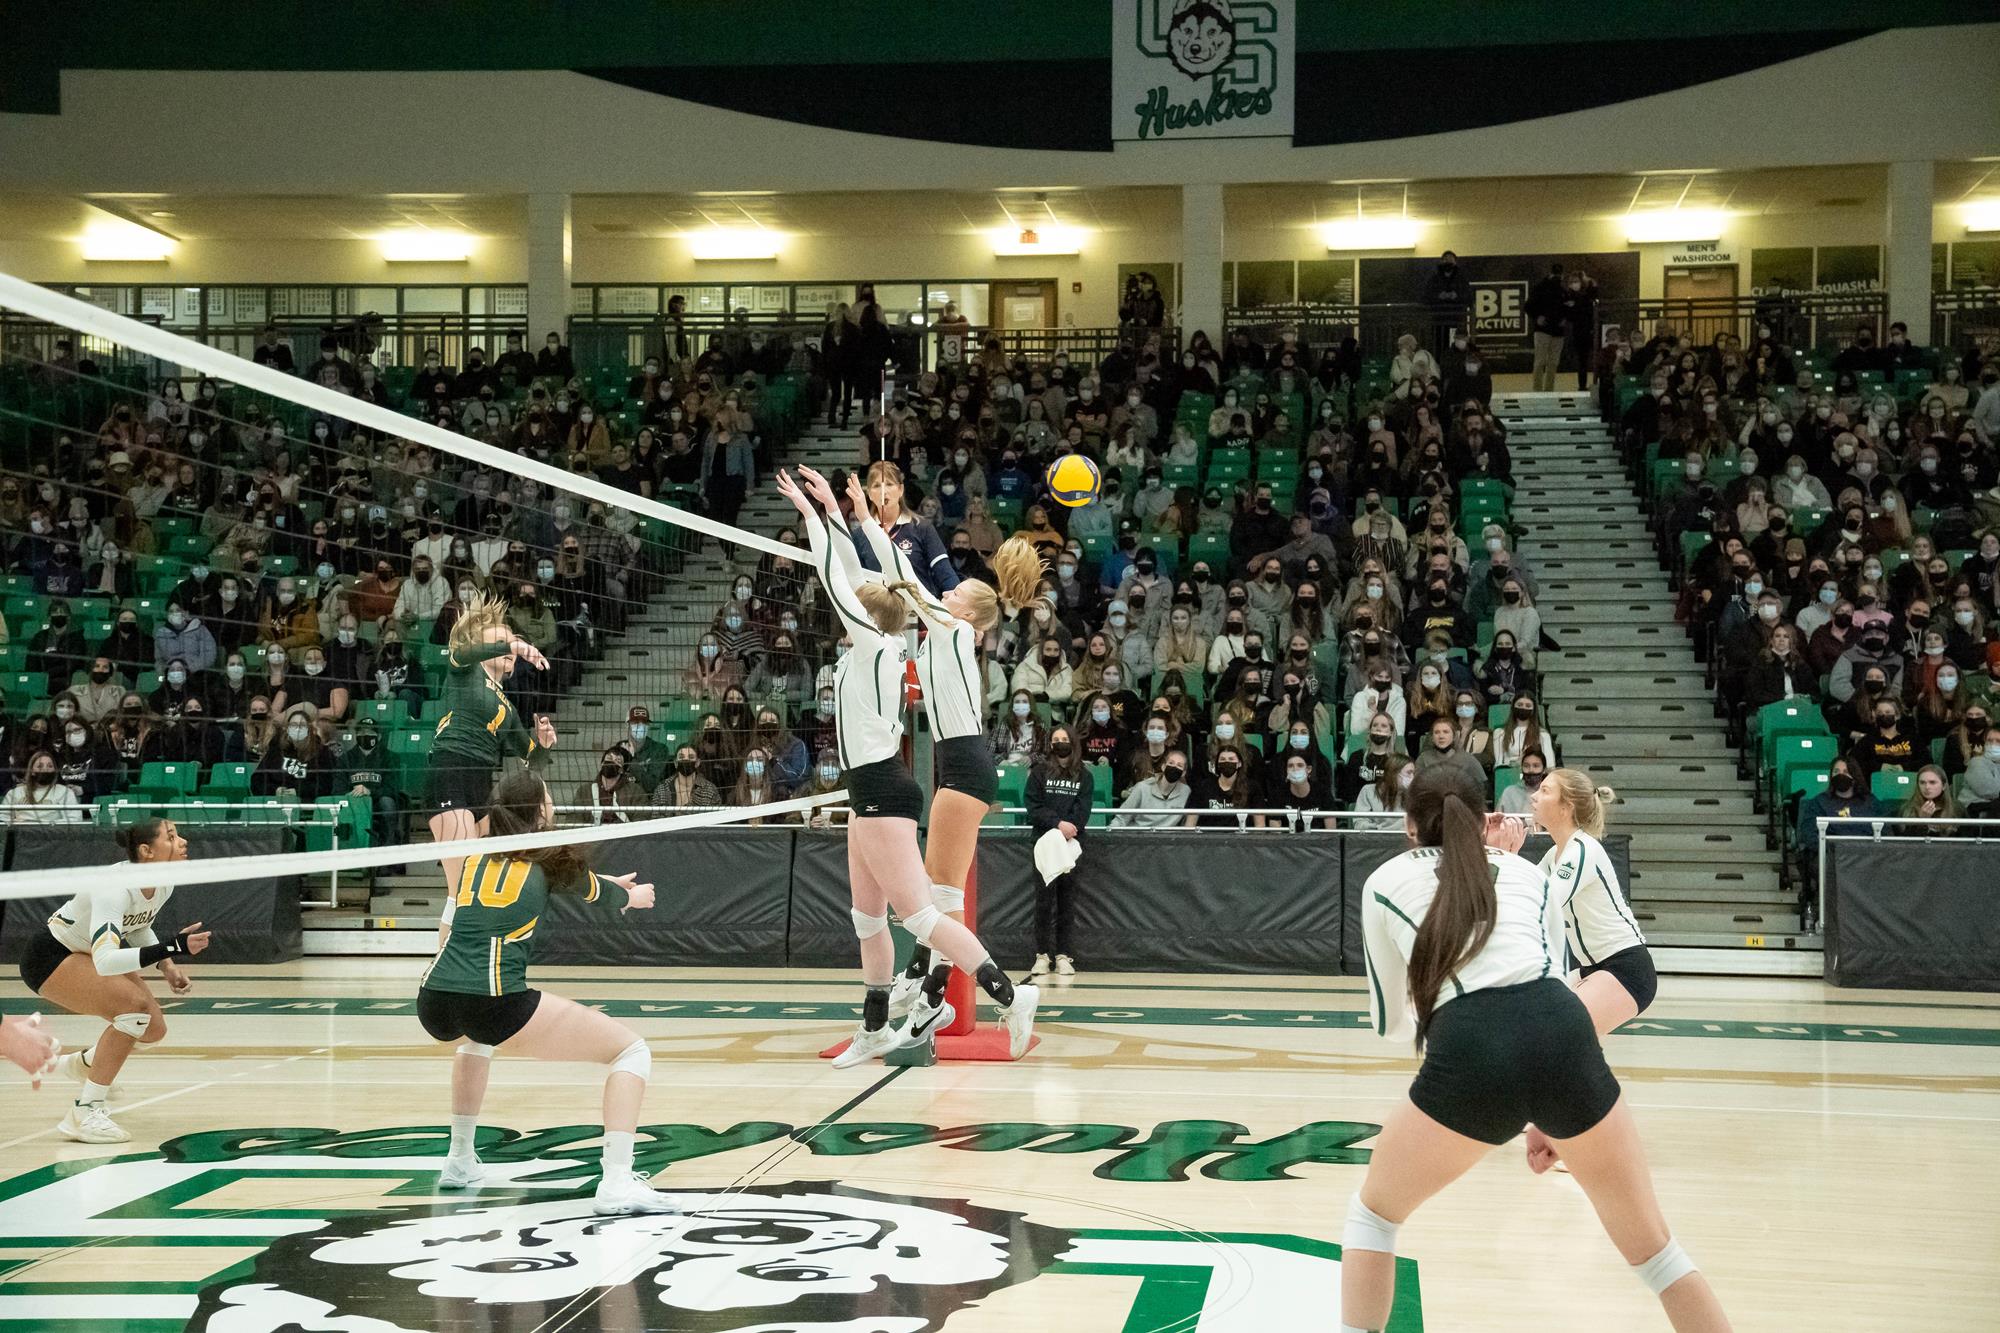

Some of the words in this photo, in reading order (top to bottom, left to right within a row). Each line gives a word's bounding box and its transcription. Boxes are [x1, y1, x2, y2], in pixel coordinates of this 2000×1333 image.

[1135, 78, 1272, 139] Huskies
[1687, 243, 1717, 252] MEN'S
[1672, 253, 1731, 262] WASHROOM
[1812, 280, 1867, 295] SQUASH
[1475, 289, 1520, 317] BE
[1475, 319, 1520, 329] ACTIVE
[456, 853, 532, 908] 10
